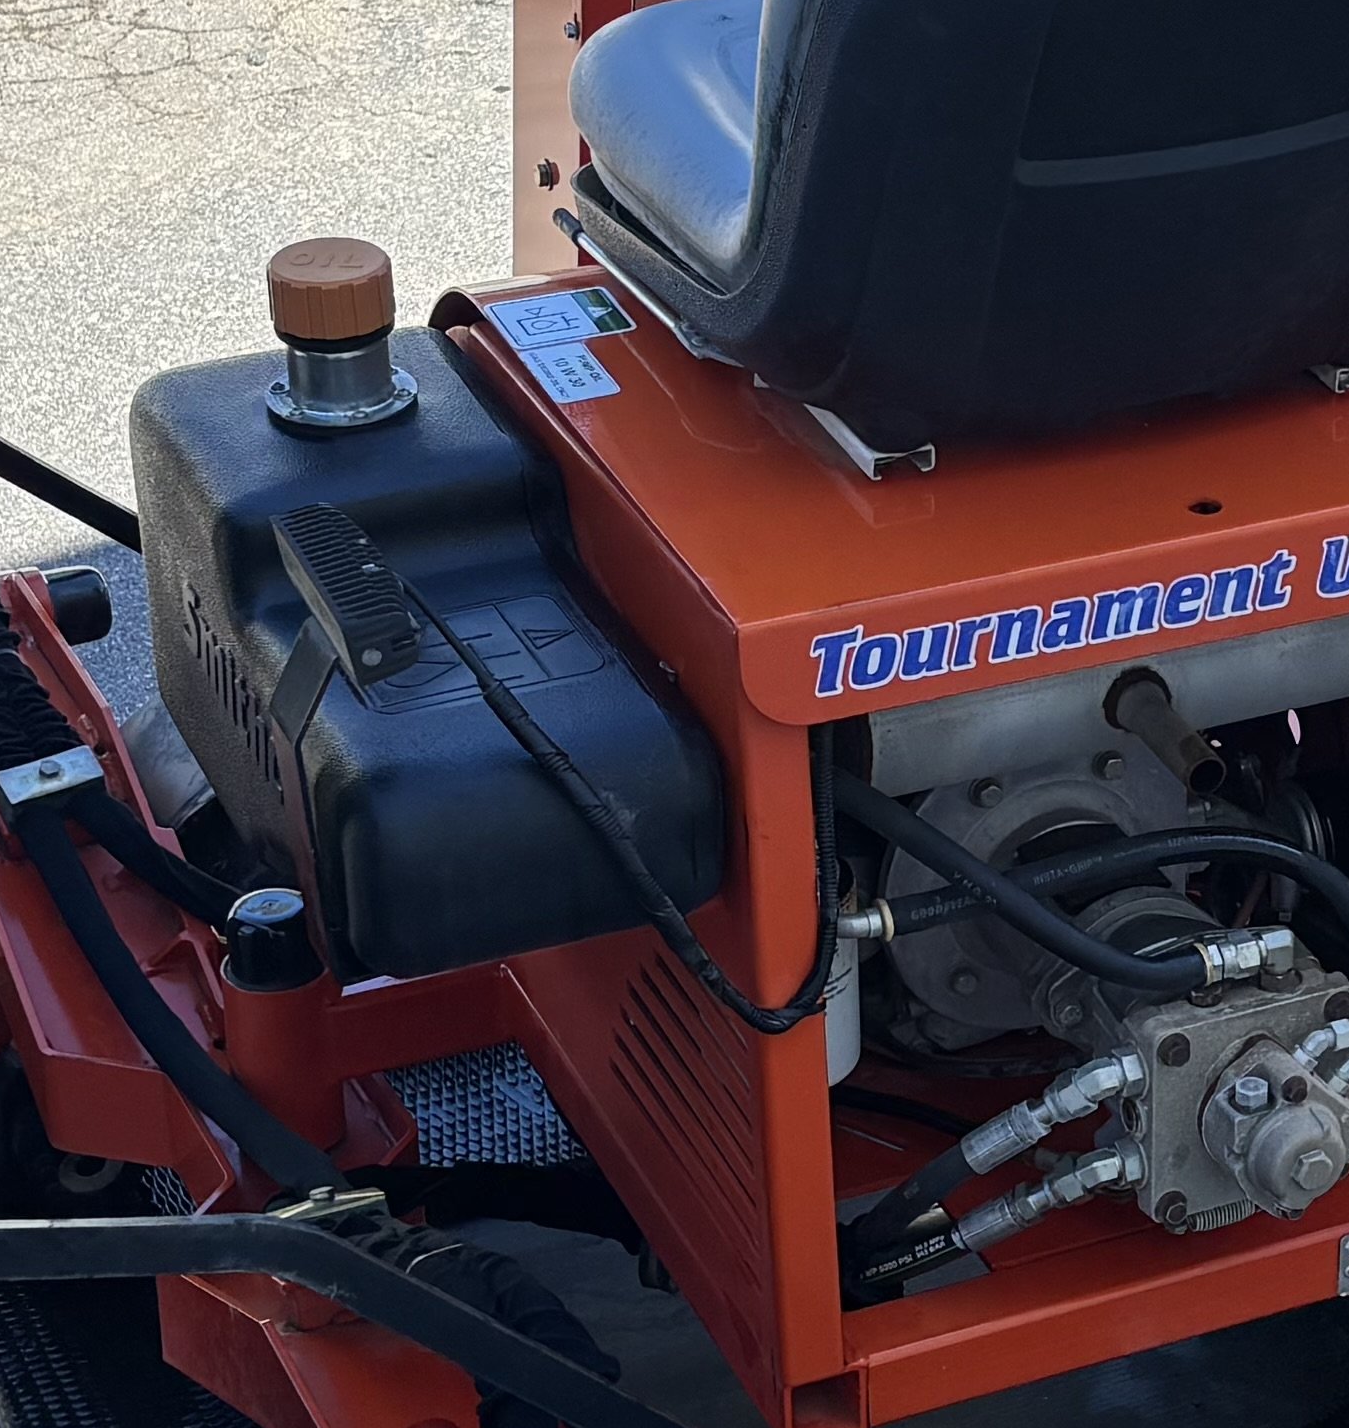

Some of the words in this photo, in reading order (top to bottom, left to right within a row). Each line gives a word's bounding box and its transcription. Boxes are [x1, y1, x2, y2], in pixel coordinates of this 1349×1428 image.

[289, 252, 365, 269] OIL
[552, 357, 569, 368] 10
[809, 548, 1294, 698] Tournament
[910, 897, 974, 921] GOODYEA
